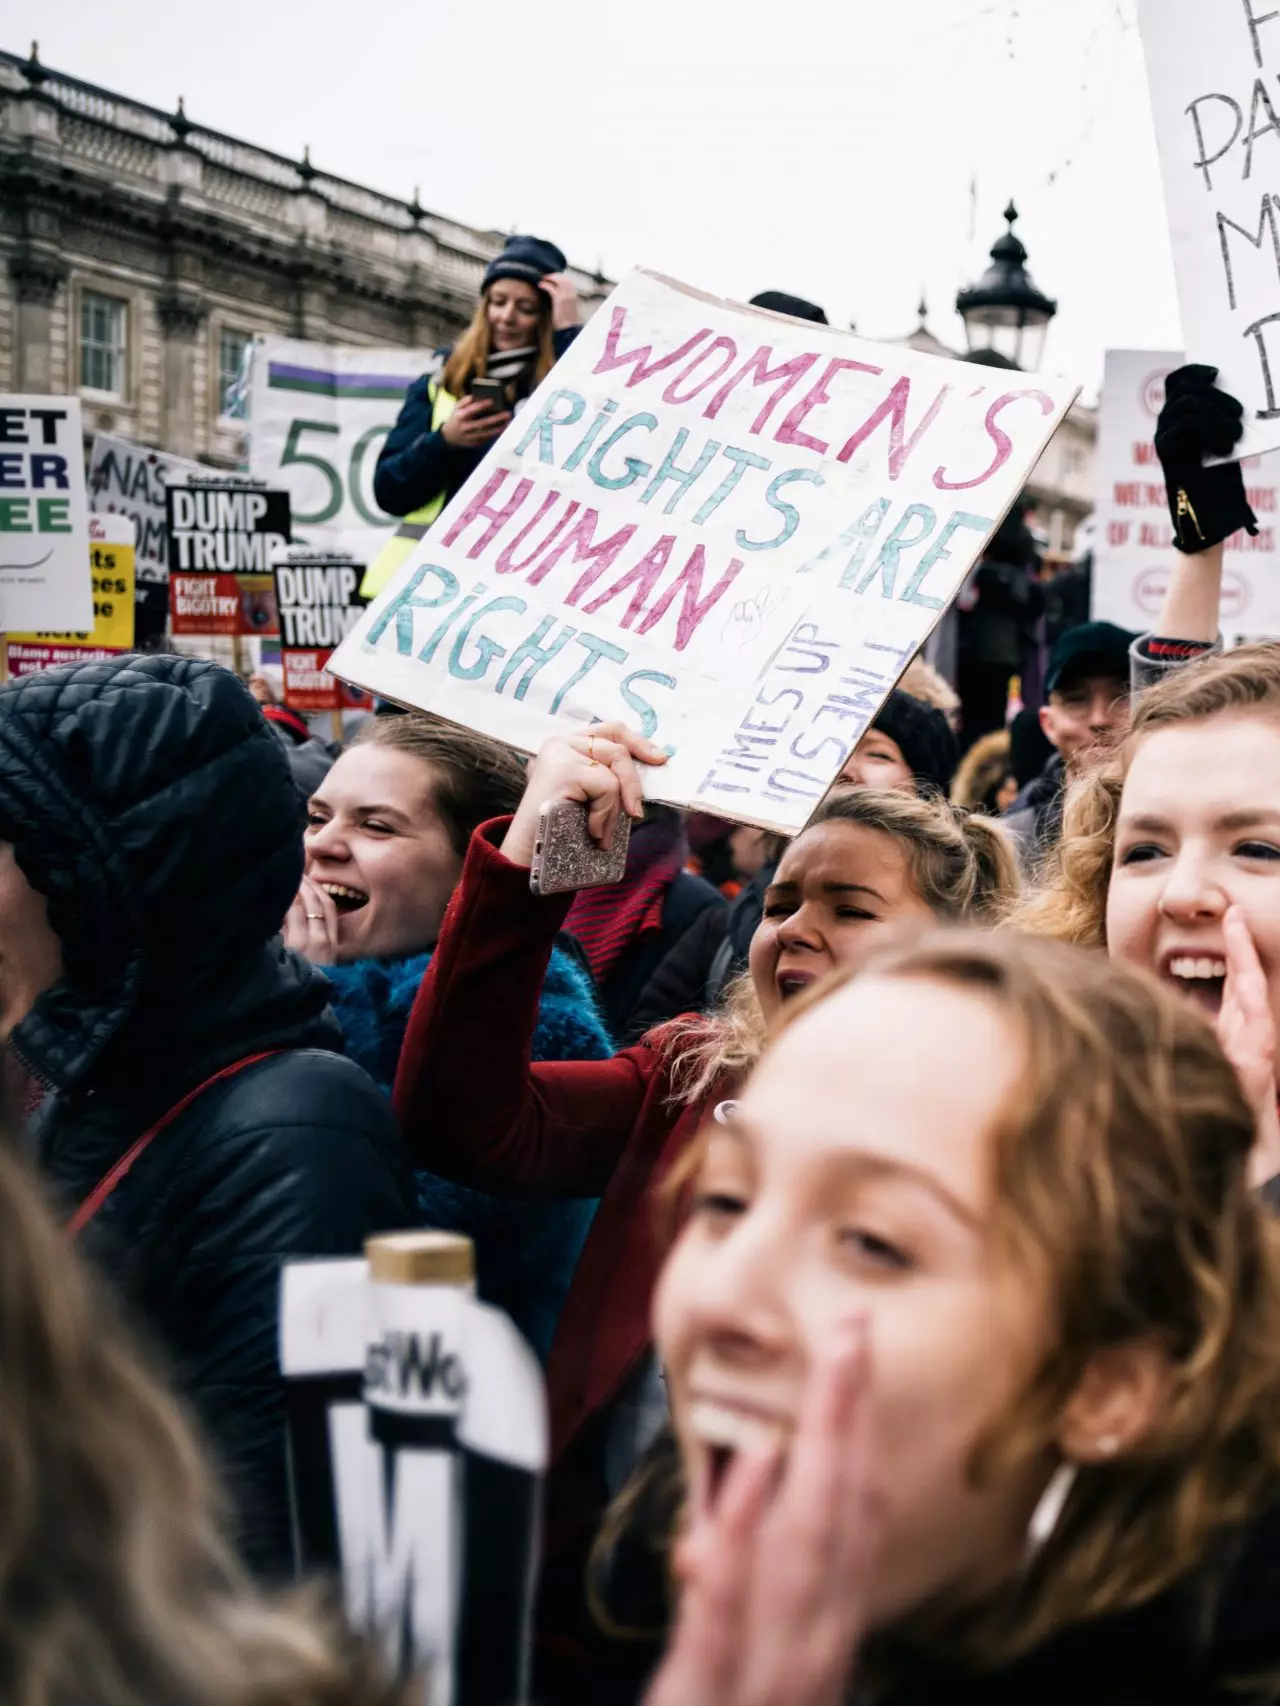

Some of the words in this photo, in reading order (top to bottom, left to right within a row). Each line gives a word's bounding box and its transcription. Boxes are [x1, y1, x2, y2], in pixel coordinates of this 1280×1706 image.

[592, 305, 1055, 490] WOMEN'S
[172, 489, 269, 533] DUMP
[172, 530, 288, 573] TRUMP
[440, 467, 745, 652] HUMAN
[796, 497, 998, 611] ARE
[175, 577, 217, 597] FIGHT
[176, 595, 239, 617] BIGOTRY
[276, 566, 358, 606] DUMP
[280, 604, 366, 647] TRUM
[774, 622, 841, 675] UP
